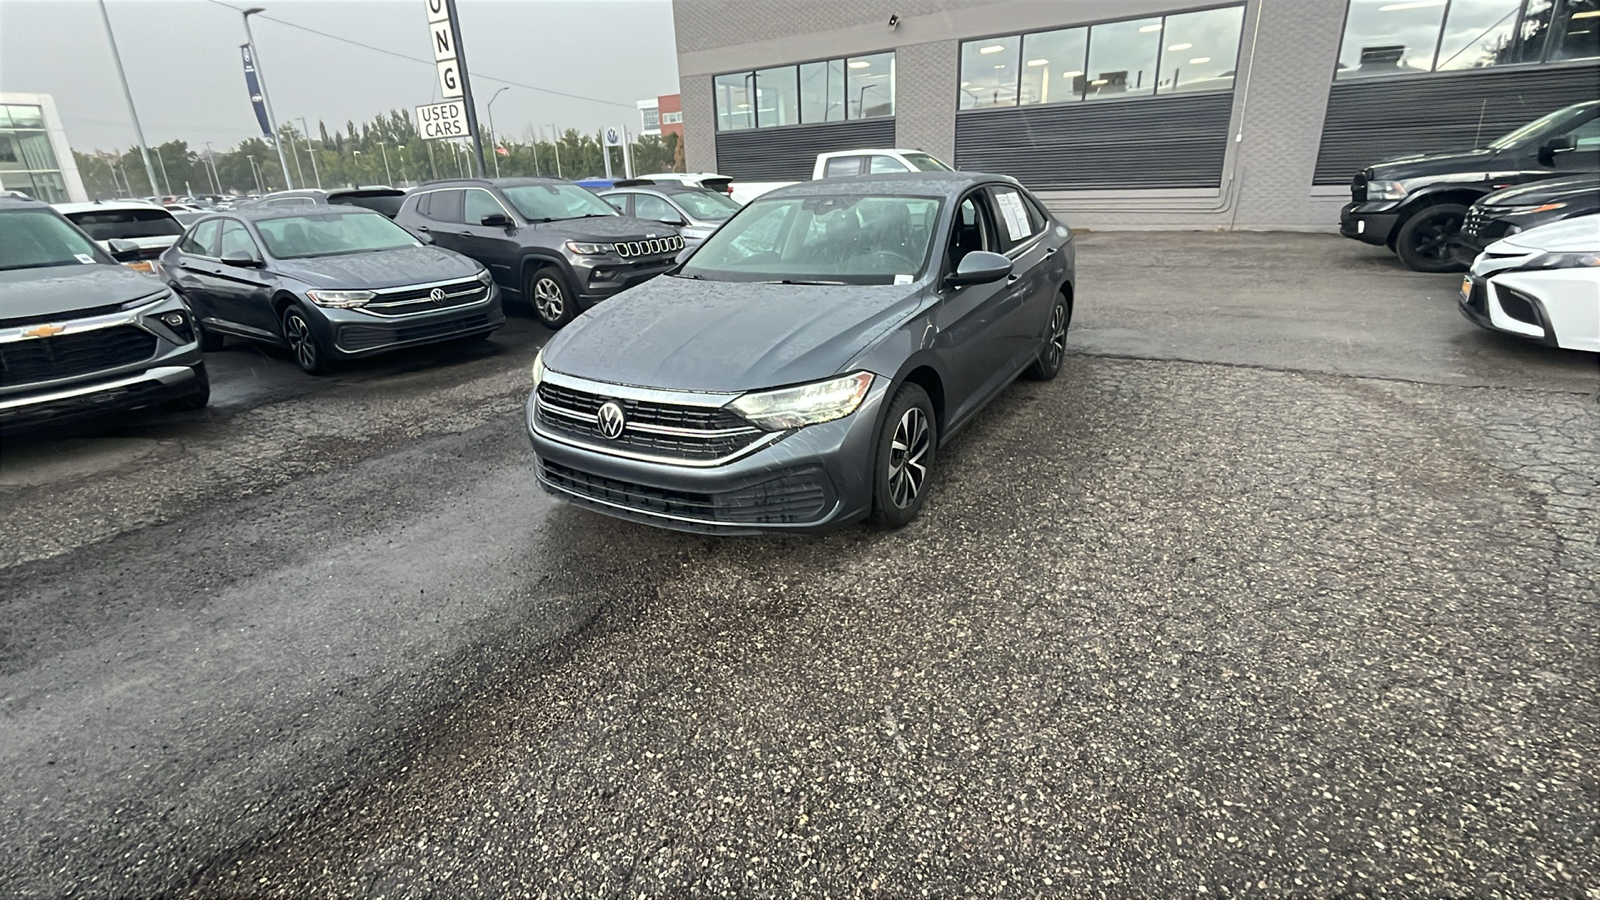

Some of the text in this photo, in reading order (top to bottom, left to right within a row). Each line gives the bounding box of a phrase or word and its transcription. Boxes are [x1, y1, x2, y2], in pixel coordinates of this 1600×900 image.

[422, 104, 459, 122] USED
[426, 120, 462, 137] CARS
[598, 402, 624, 439] VW
